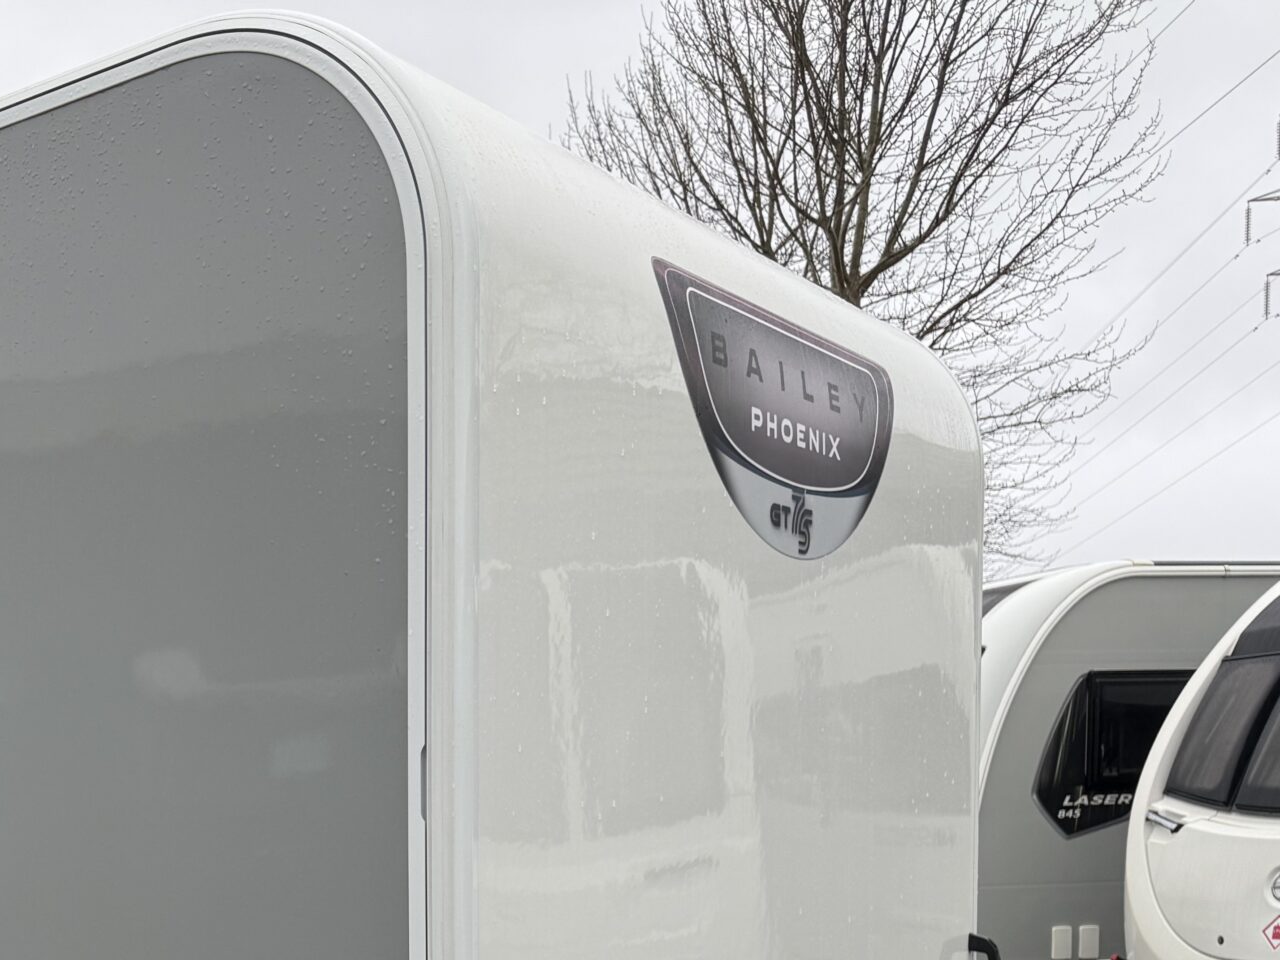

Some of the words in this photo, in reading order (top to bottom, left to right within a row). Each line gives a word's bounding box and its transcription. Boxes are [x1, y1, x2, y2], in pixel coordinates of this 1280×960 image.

[710, 331, 869, 423] BAILEY
[751, 405, 841, 461] PHOENIX
[1062, 793, 1134, 807] LASER
